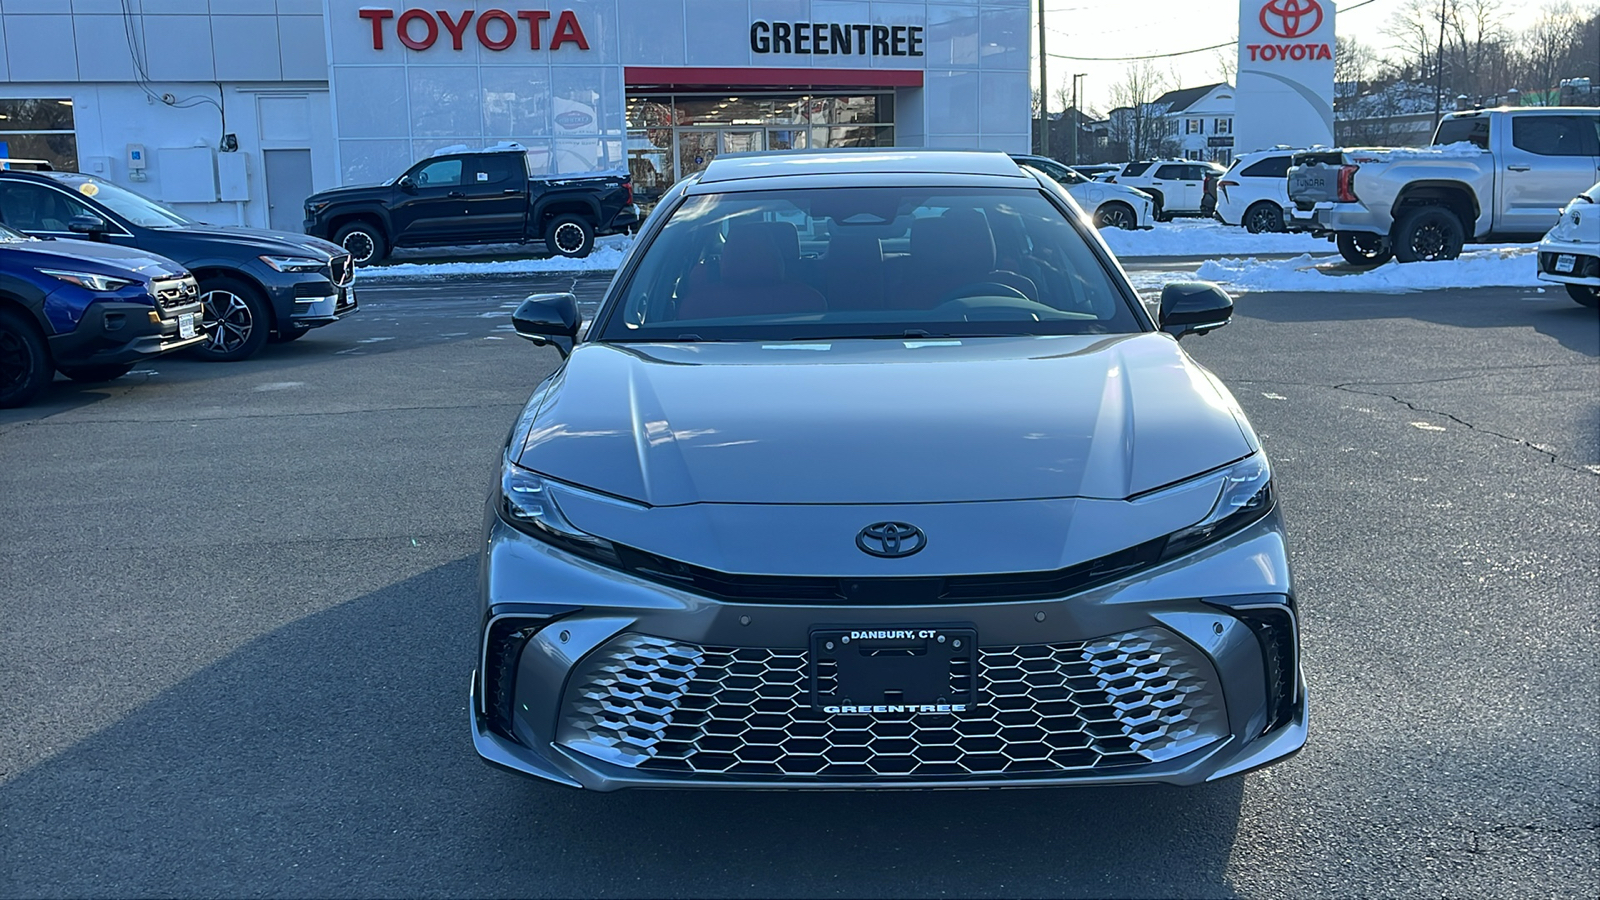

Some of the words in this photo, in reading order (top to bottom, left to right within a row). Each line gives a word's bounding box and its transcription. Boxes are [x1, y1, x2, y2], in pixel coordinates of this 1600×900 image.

[359, 9, 590, 51] TOYOTA
[750, 21, 924, 56] GREENTREE
[1246, 44, 1332, 61] TOYOTA
[1296, 179, 1325, 187] TUNDRA
[851, 630, 915, 640] DANBURY,
[918, 630, 937, 639] CT
[823, 704, 967, 713] GREENTREE
